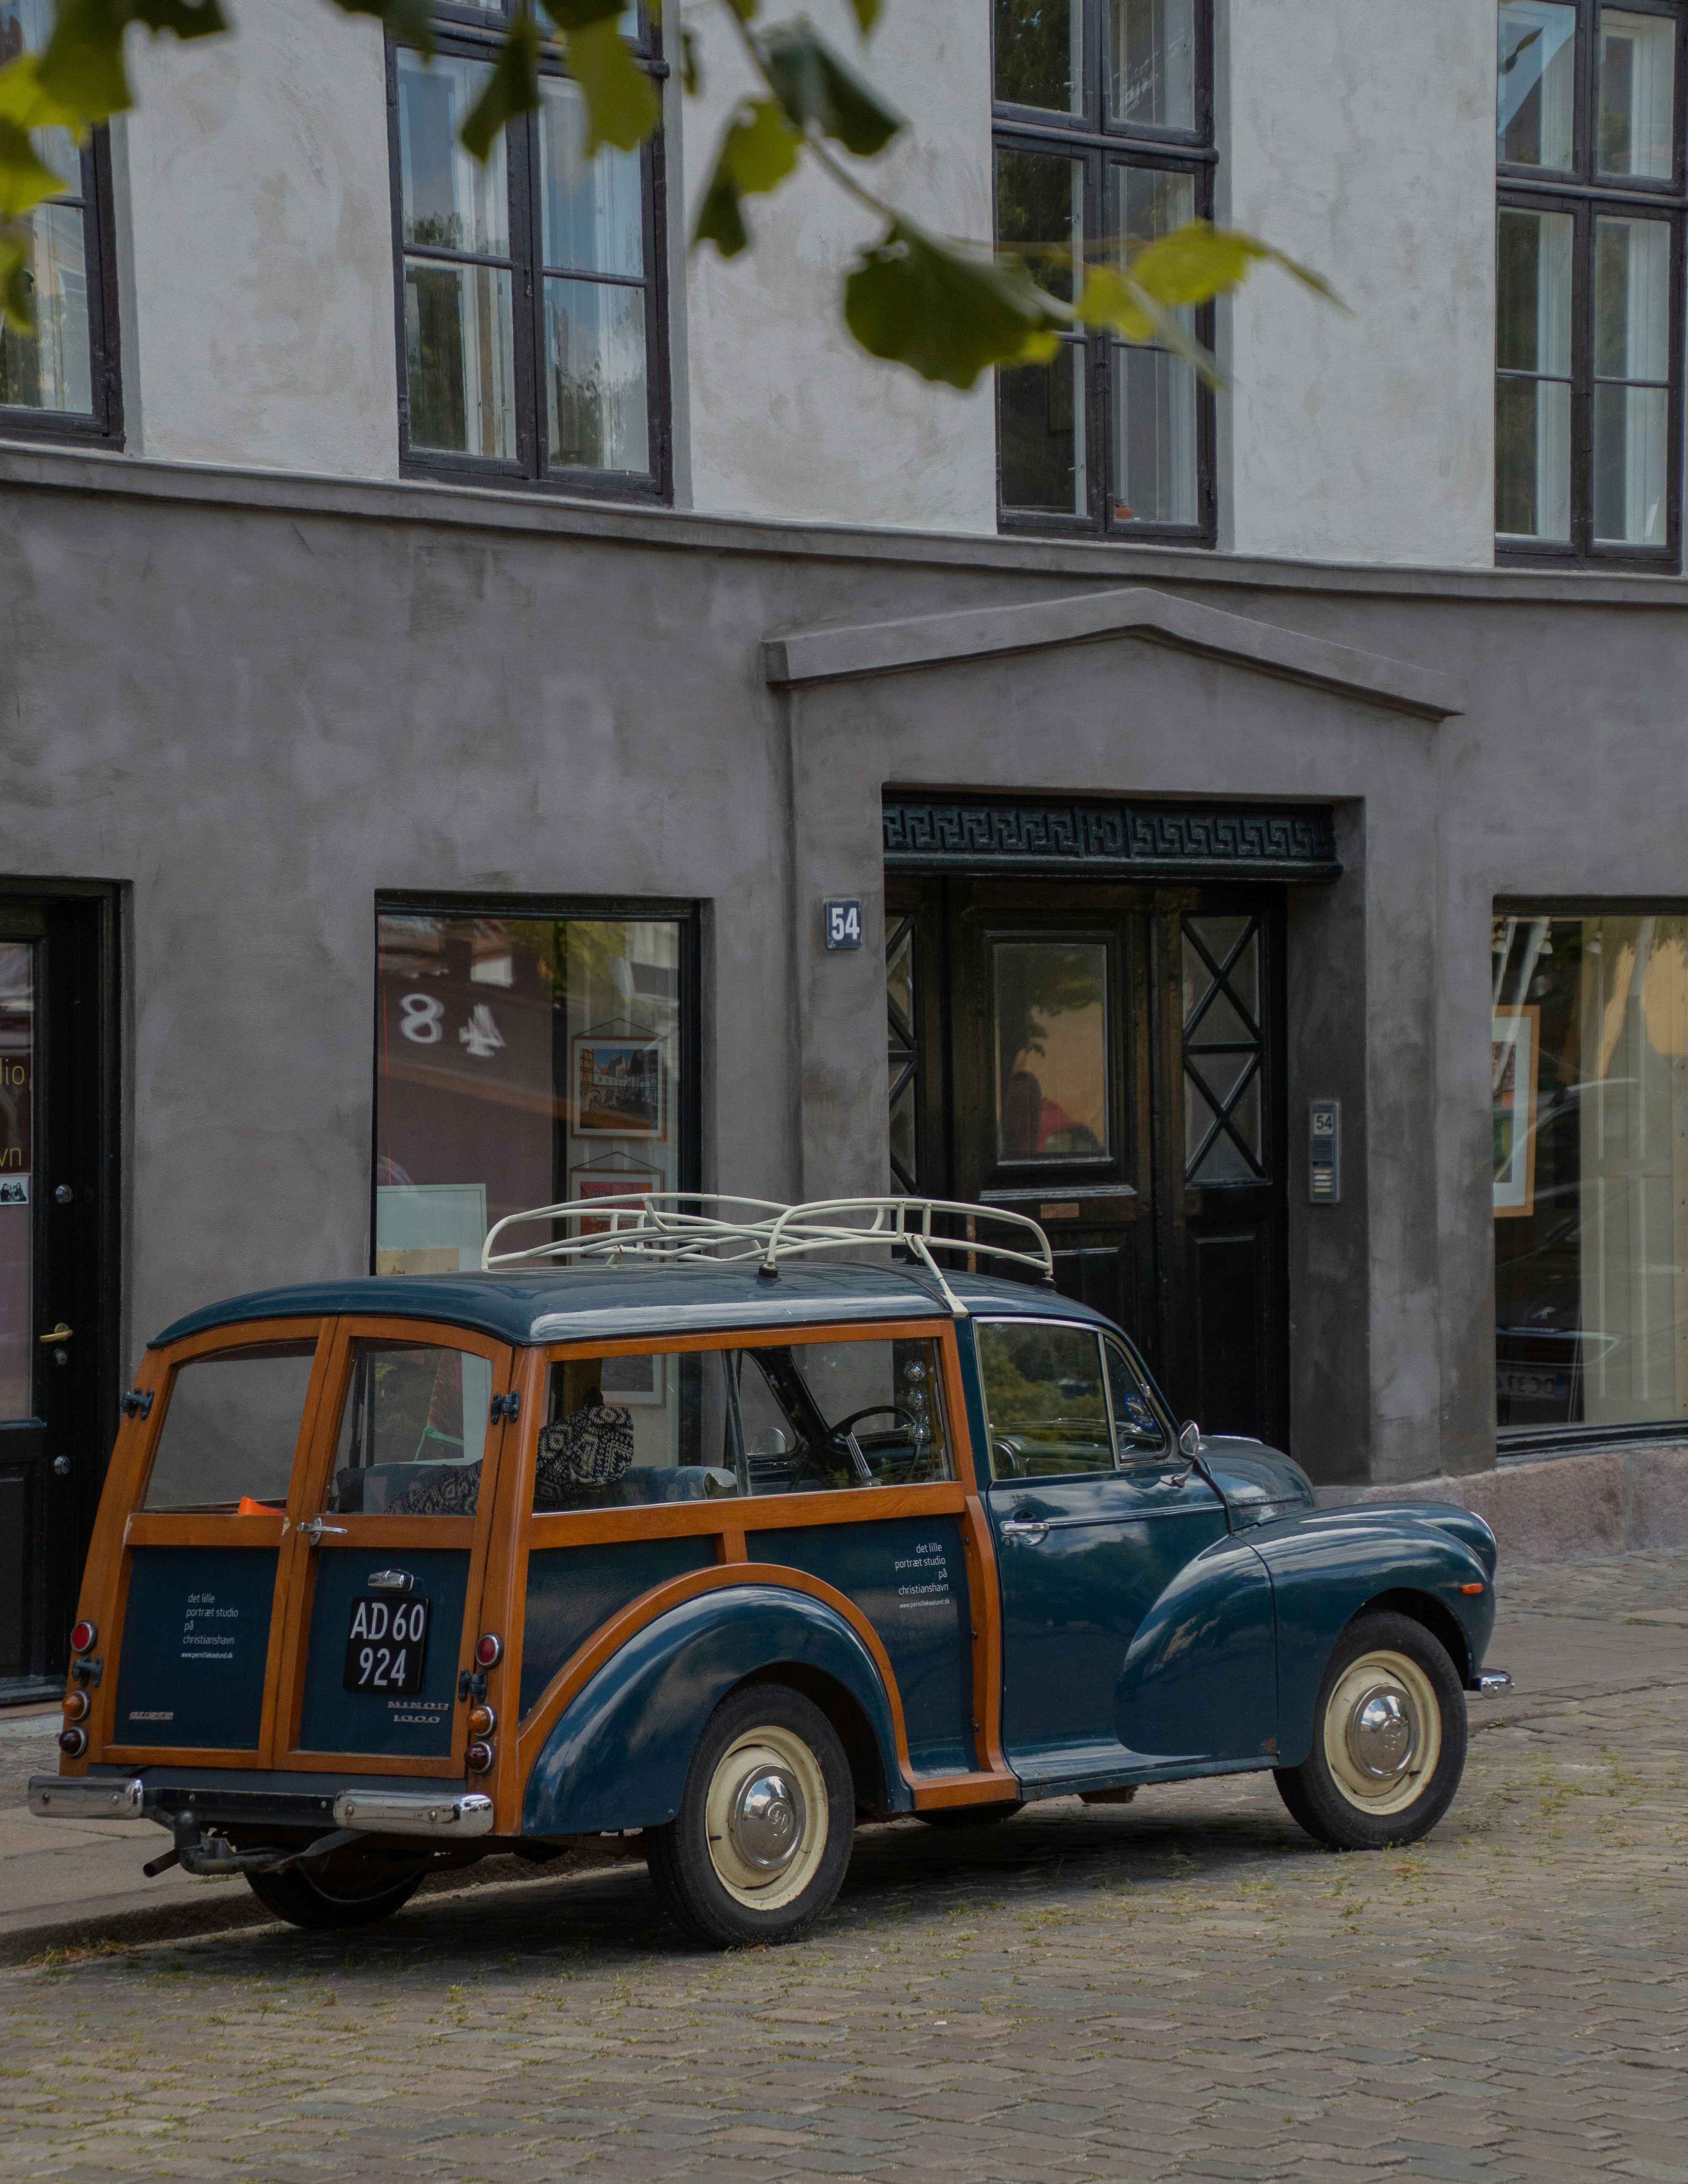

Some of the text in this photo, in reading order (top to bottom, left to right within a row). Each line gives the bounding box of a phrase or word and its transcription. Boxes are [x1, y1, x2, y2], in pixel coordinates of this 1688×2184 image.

[832, 908, 860, 940] 54
[1316, 1114, 1333, 1130] 54
[916, 1543, 942, 1554] det lille
[895, 1556, 946, 1571] portræt studio
[938, 1568, 947, 1581] på
[899, 1583, 949, 1595] christianshavn
[188, 1592, 215, 1603] det lille
[899, 1598, 950, 1609] www.pernillekaalund.dk
[186, 1607, 238, 1619] portræt studio
[184, 1619, 194, 1633] på
[183, 1634, 235, 1645] christianshavn
[358, 1647, 406, 1687] 924
[393, 1714, 441, 1724] 1000
